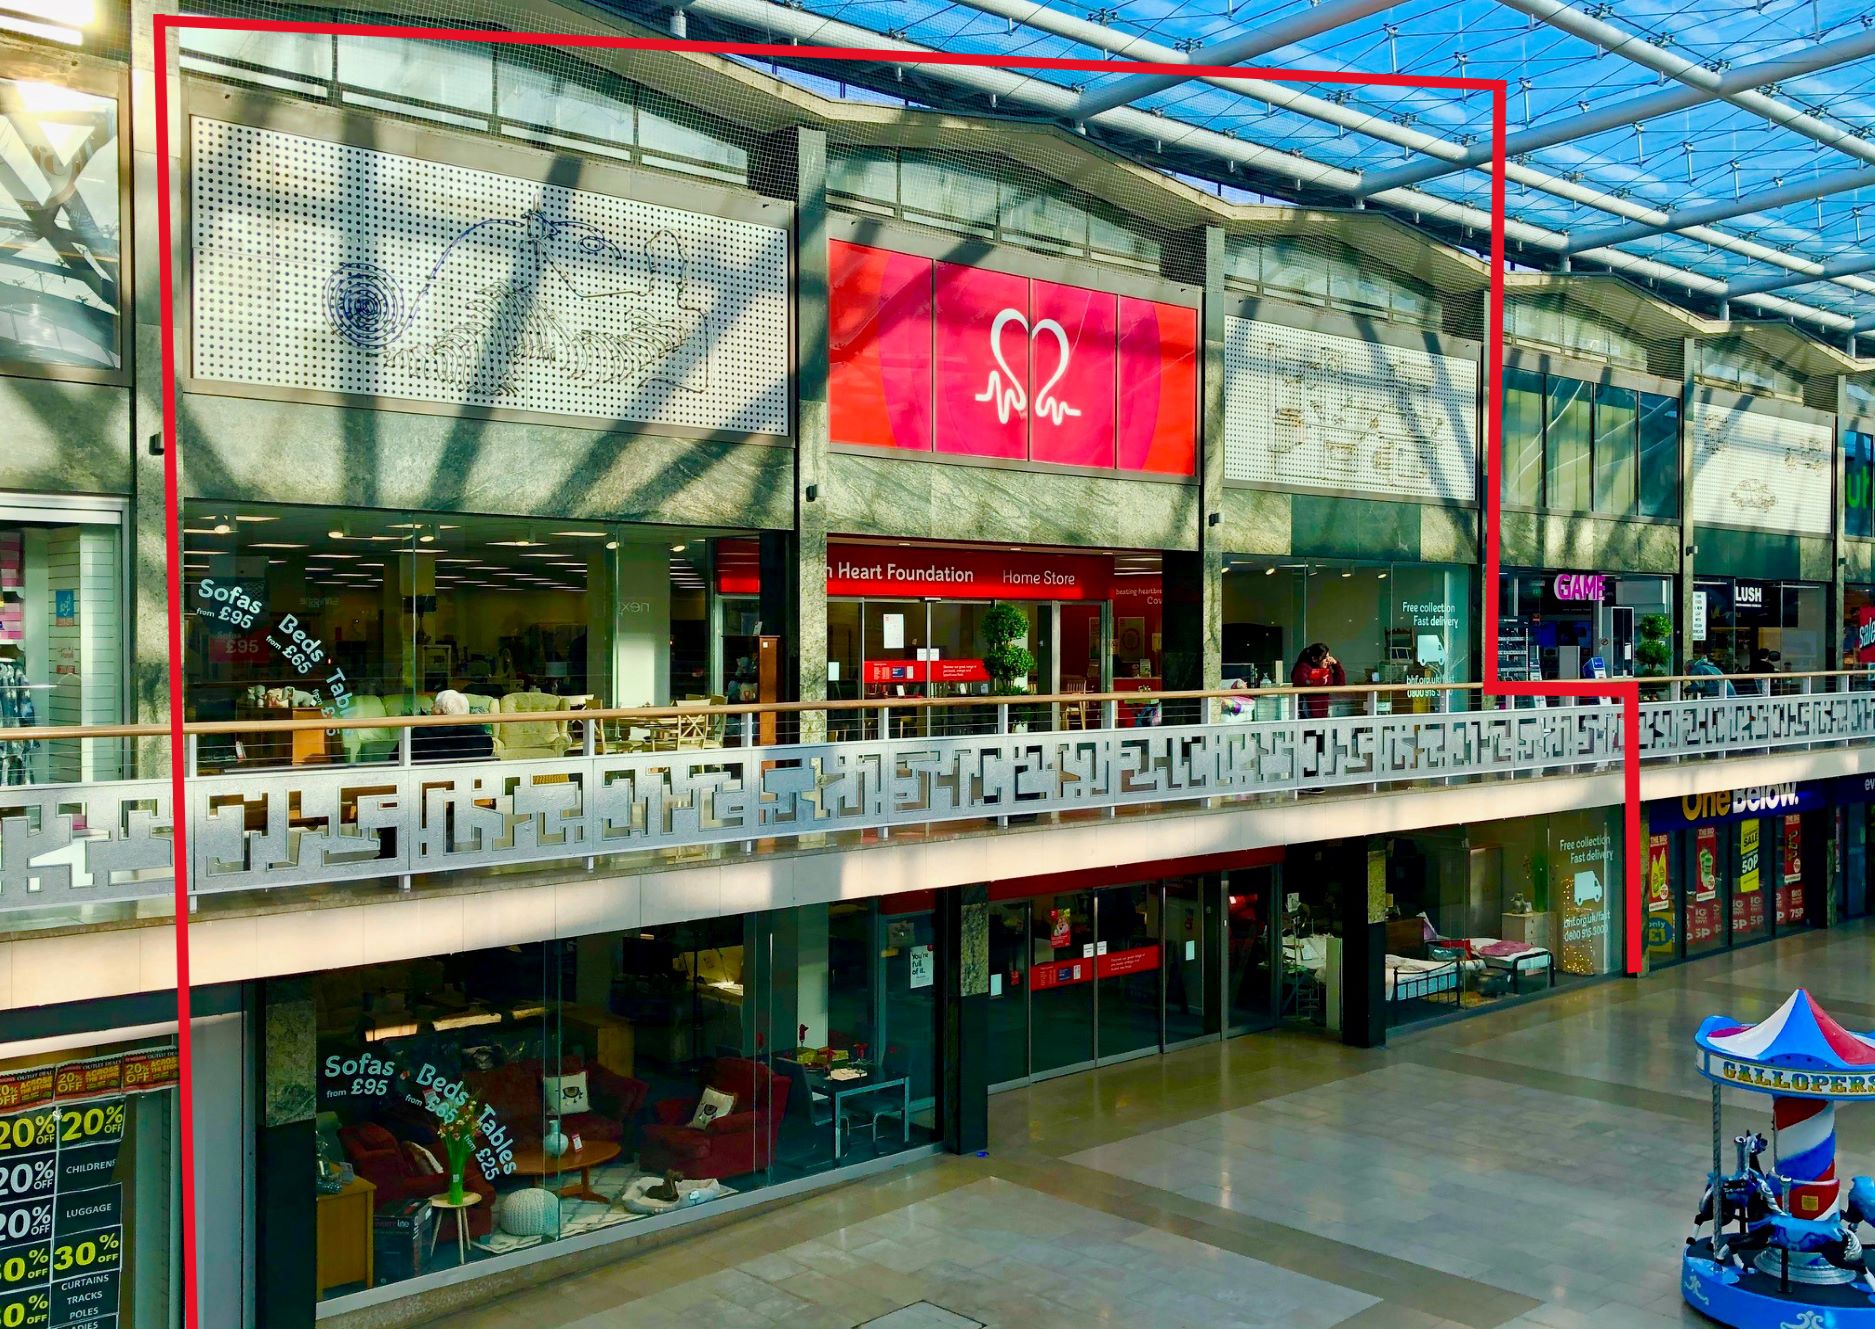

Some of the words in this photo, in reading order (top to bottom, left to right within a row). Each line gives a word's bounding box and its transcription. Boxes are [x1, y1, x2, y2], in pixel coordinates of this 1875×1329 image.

[838, 562, 883, 579] Heart
[887, 563, 974, 582] Foundation
[1002, 570, 1041, 584] Home
[1043, 570, 1075, 585] Store
[1554, 573, 1606, 601] GAME
[1735, 586, 1762, 602] LUSH
[198, 579, 263, 614] Sofas
[1402, 602, 1418, 613] Free
[196, 608, 215, 617] from
[218, 606, 254, 628] £95
[1413, 615, 1429, 626] Fast
[1430, 615, 1459, 629] delivery
[278, 613, 325, 663] Beds
[265, 635, 282, 650] from
[282, 645, 312, 674] £65
[1682, 789, 1731, 821] One
[1560, 839, 1575, 852] Free
[1576, 835, 1611, 849] collection
[1743, 832, 1759, 847] SALE
[1570, 852, 1585, 864] Fast
[1586, 848, 1614, 862] delivery
[324, 1052, 396, 1078] Sofas
[126, 1072, 150, 1083] OFF
[415, 1062, 470, 1107] Beds
[0, 1084, 17, 1097] 0%
[57, 1081, 82, 1092] OFF
[326, 1089, 347, 1098] from
[350, 1078, 389, 1096] £95
[405, 1094, 423, 1107] from
[424, 1095, 459, 1124] £65
[61, 1105, 123, 1141] 20%
[104, 1123, 122, 1134] OFF
[36, 1134, 55, 1145] OFF
[476, 1103, 517, 1175] Tables
[464, 1134, 477, 1150] from
[475, 1147, 500, 1181] £25
[33, 1179, 53, 1190] OFF
[66, 1203, 112, 1218] LUGGAGE
[30, 1224, 51, 1235] OFF
[53, 1232, 119, 1271] 30%
[98, 1253, 119, 1263] OFF
[0, 1248, 49, 1282] 0%
[27, 1268, 48, 1279] OFF
[61, 1274, 109, 1291] CURTAINS
[66, 1291, 103, 1305] TRACKS
[0, 1293, 49, 1328] 0%
[69, 1307, 99, 1320] POLES
[26, 1314, 48, 1325] OFF
